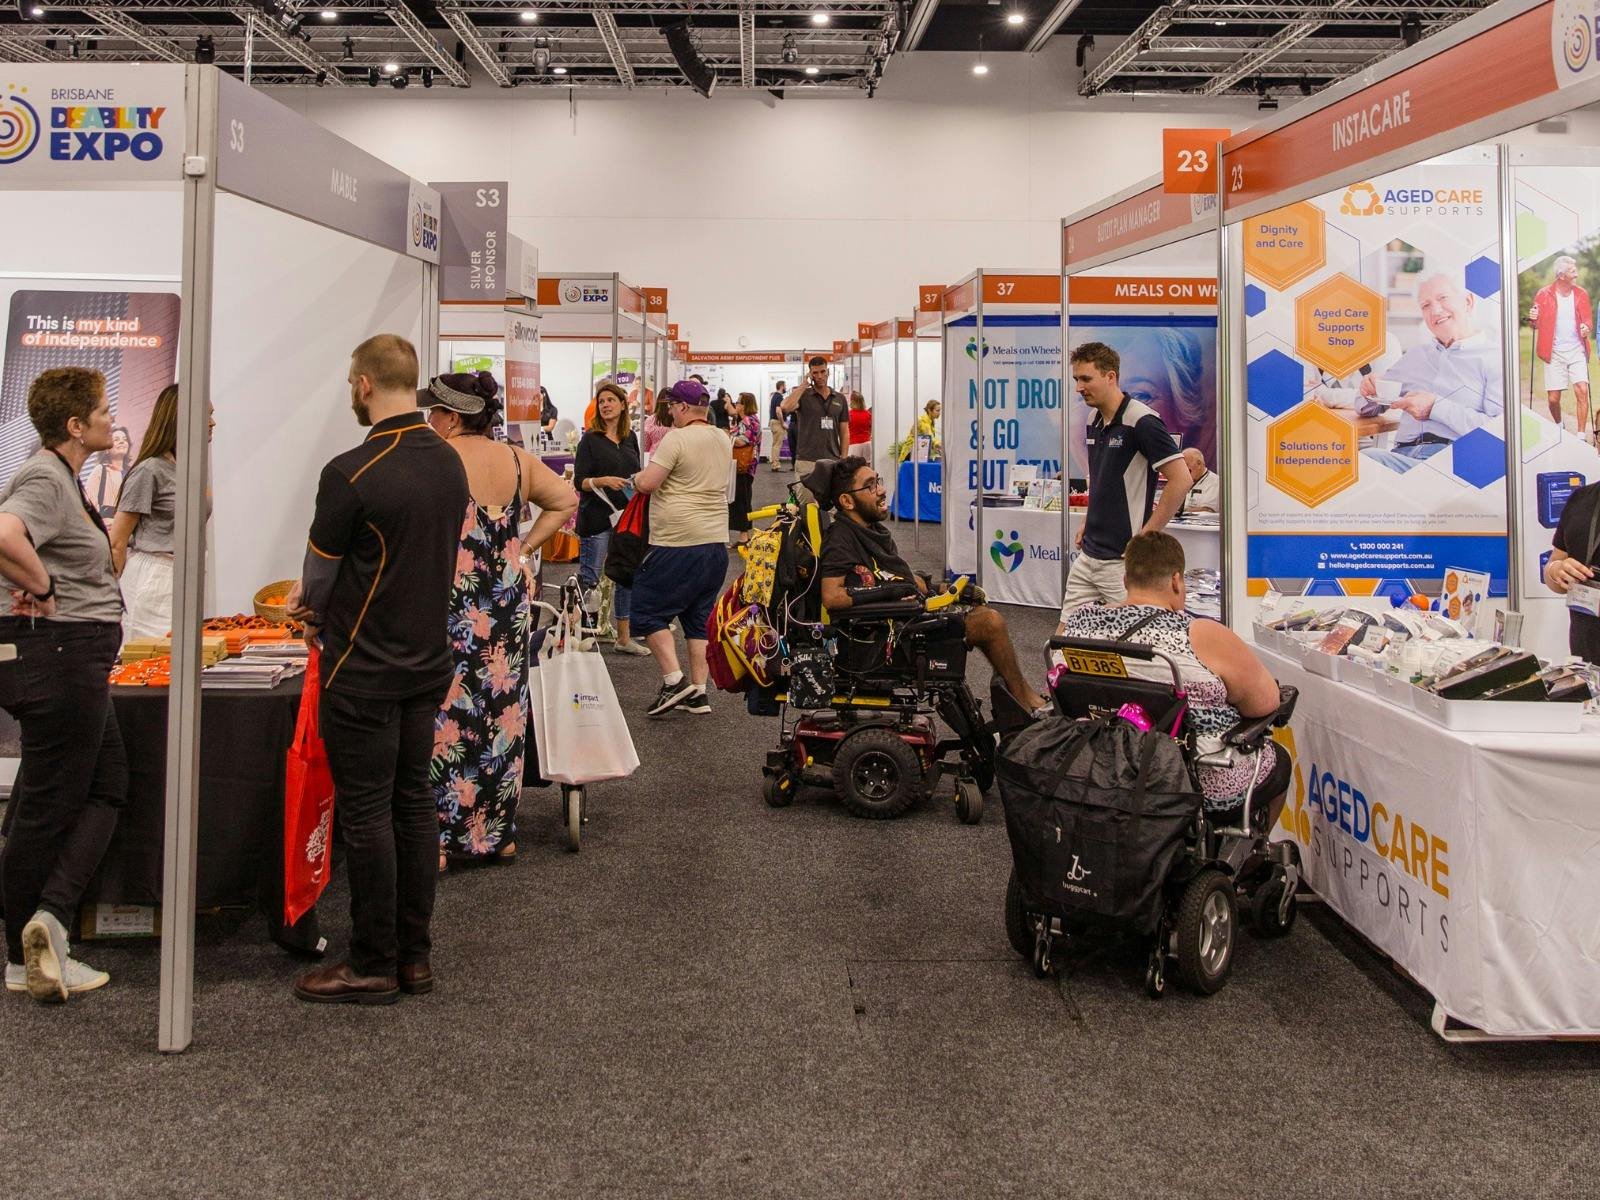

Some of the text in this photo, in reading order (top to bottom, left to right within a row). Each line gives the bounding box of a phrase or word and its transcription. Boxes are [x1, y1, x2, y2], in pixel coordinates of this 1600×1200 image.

[51, 88, 114, 100] BRISBANE
[51, 106, 166, 129] DISABILITY
[1332, 90, 1411, 151] INSTACARE
[230, 119, 245, 152] S3
[50, 132, 163, 161] EXPO
[1177, 150, 1209, 172] 23
[331, 167, 358, 202] MABLE
[1231, 164, 1243, 192] 23
[476, 188, 500, 208] S3
[1384, 189, 1483, 204] AGEDCARE
[1129, 200, 1161, 230] MANAGER
[1388, 206, 1484, 216] SUPPORTS
[422, 229, 438, 251] EXPO
[1260, 225, 1298, 237] Dignity
[1256, 238, 1304, 248] and Care
[471, 250, 481, 289] SILVER
[485, 231, 497, 289] SPONSOR
[924, 293, 938, 304] 37
[996, 283, 1015, 296] 37
[1115, 284, 1164, 297] MEALS
[1168, 284, 1193, 297] ON
[649, 296, 663, 305] 38
[1313, 308, 1368, 321] Aged Care
[27, 315, 139, 334] This is my kind
[1318, 322, 1365, 335] Supports
[24, 331, 158, 350] of independence
[1328, 336, 1355, 348] Shop
[992, 346, 1018, 355] Meals
[1031, 346, 1061, 355] Wheels
[969, 378, 1062, 409] NOT DRO
[993, 419, 1019, 450] GO
[1279, 441, 1346, 452] Solutions for
[1275, 455, 1351, 467] Independence
[969, 460, 1008, 490] BUT
[1030, 544, 1060, 561] Meal
[1330, 552, 1432, 560] www.agedcaresupports.com.au
[1329, 562, 1435, 570] hello@agedcaresupports.com.au
[1308, 763, 1449, 899] AGEDCARE
[1311, 826, 1449, 953] SUPPORTS
